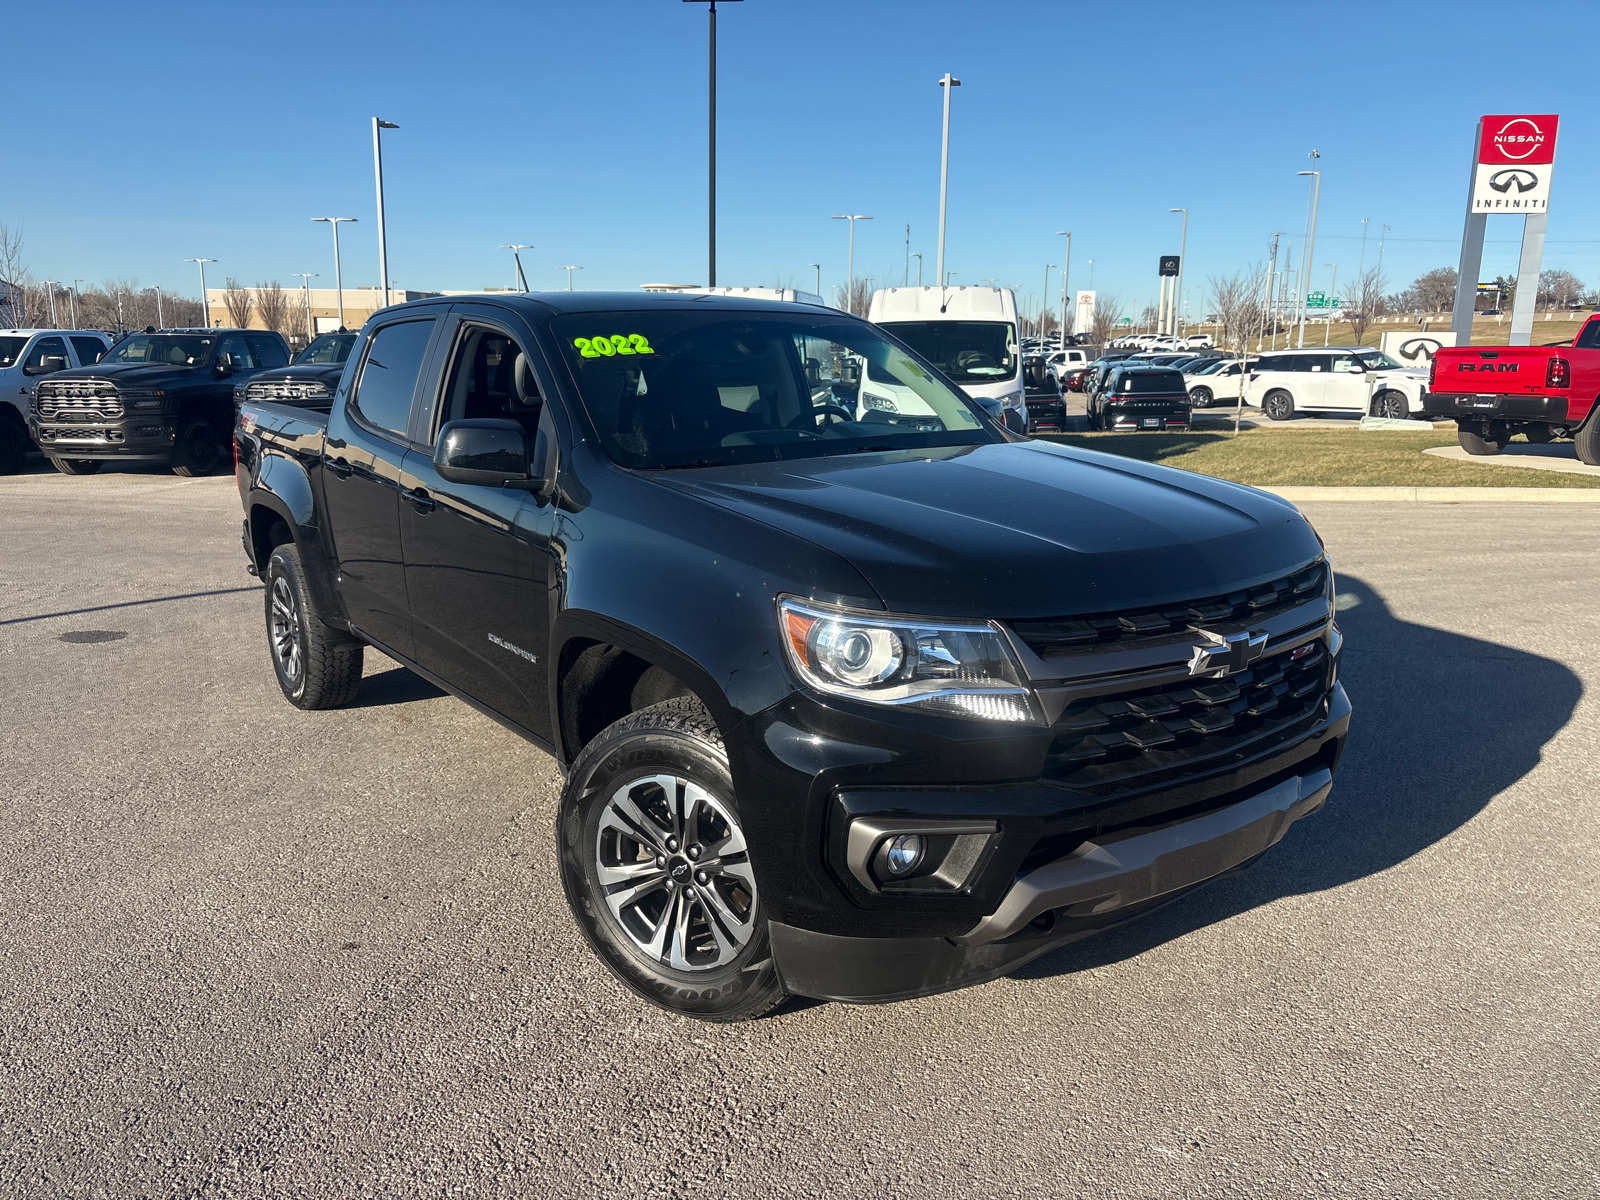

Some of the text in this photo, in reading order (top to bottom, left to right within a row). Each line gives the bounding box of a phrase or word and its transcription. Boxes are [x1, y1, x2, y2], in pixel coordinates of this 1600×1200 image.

[1494, 135, 1544, 143] NISSAN
[1476, 199, 1546, 208] INFINITI
[574, 334, 655, 358] 2022
[1458, 363, 1519, 373] RAM
[54, 388, 95, 396] RAM
